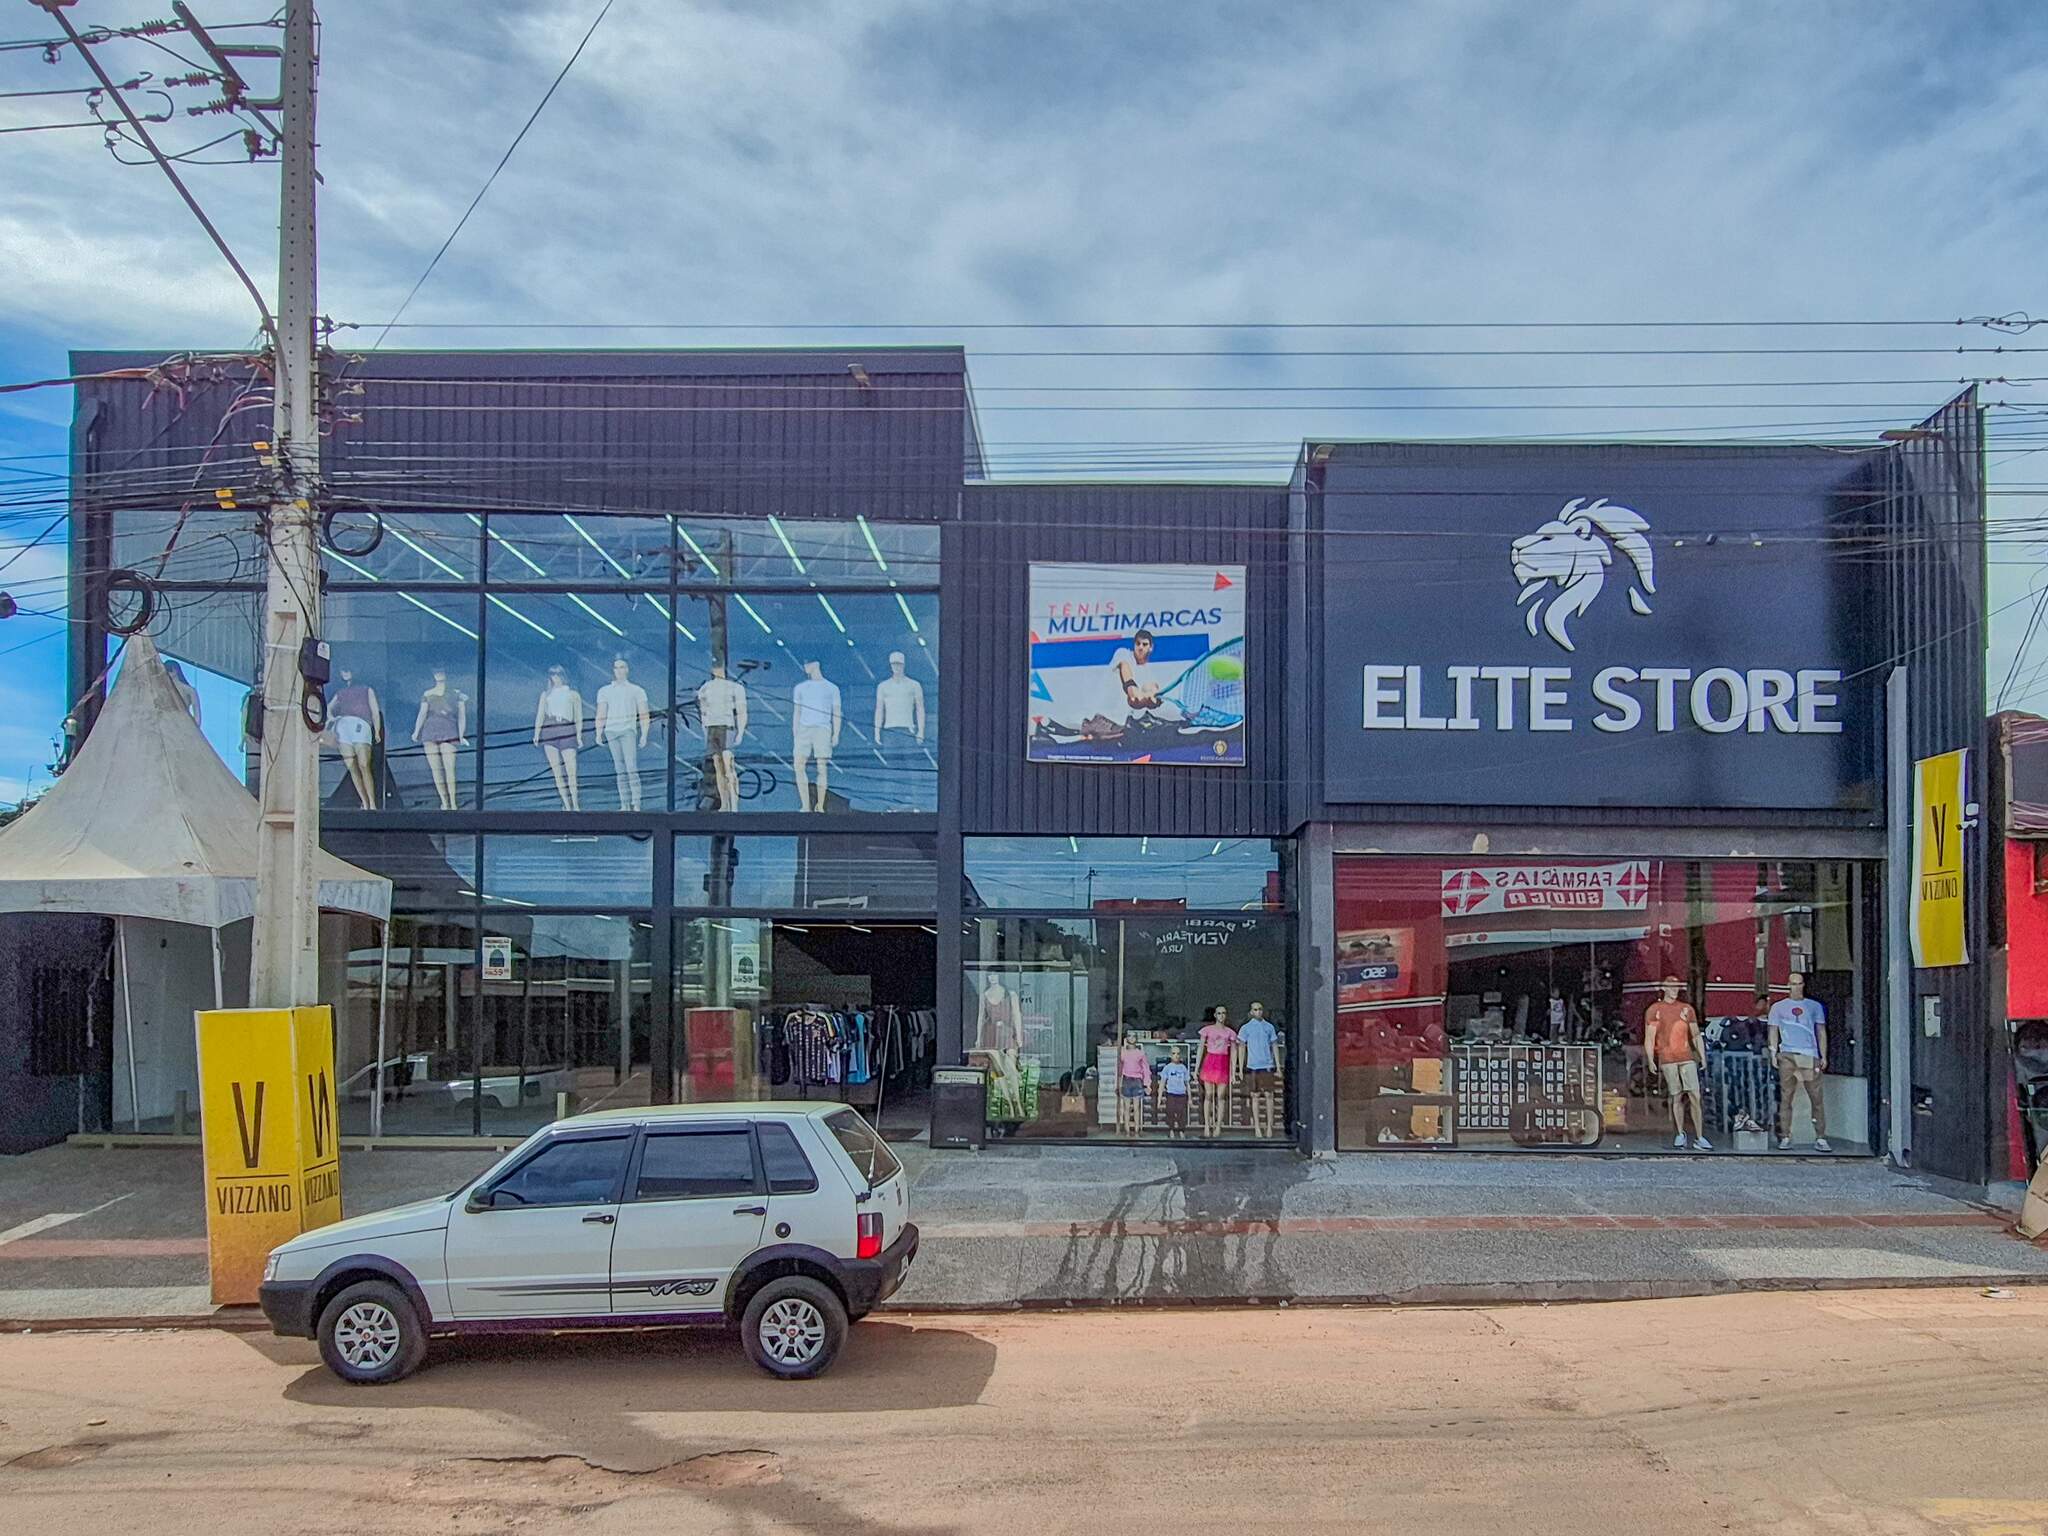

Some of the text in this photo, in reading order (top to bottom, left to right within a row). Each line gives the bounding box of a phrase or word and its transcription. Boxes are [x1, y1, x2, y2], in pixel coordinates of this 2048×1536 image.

[1048, 607, 1222, 634] MULTIMARCAS
[1363, 664, 1844, 734] ELITE STORE
[1931, 803, 1947, 867] V
[231, 1081, 265, 1168] V
[216, 1184, 292, 1215] VIZZANO
